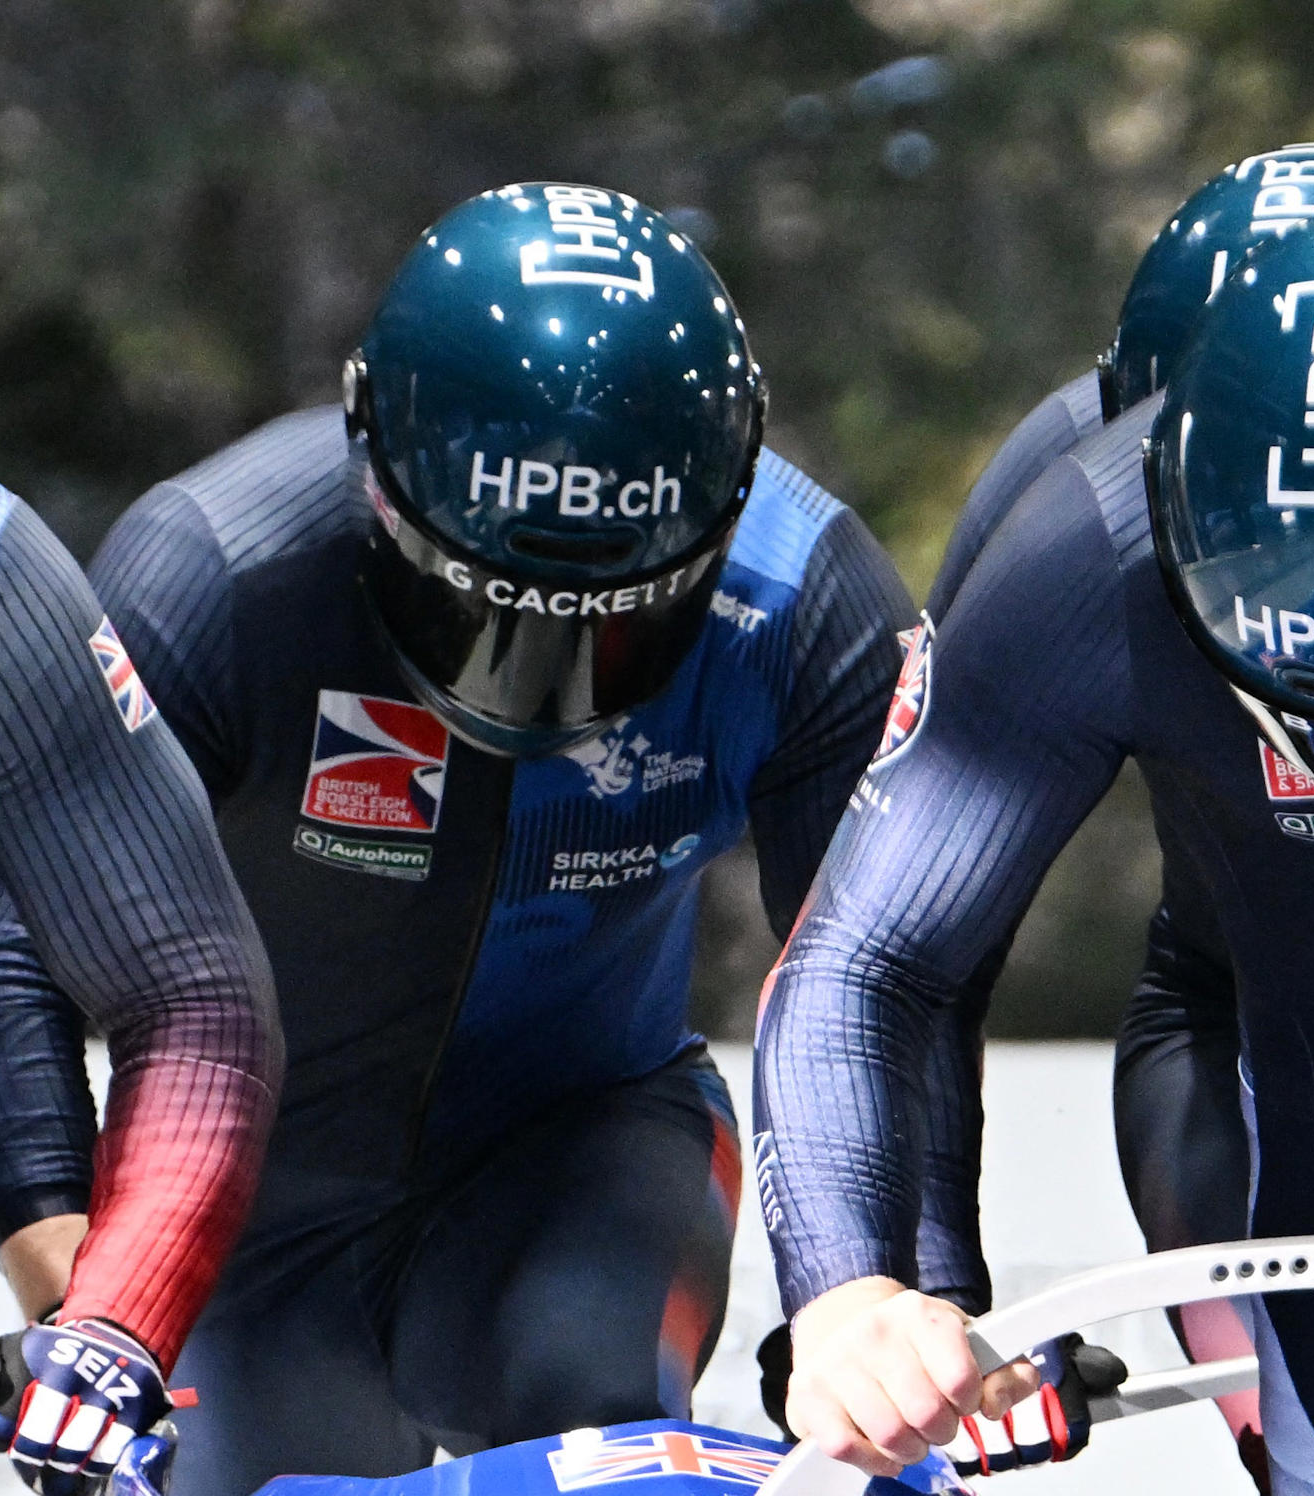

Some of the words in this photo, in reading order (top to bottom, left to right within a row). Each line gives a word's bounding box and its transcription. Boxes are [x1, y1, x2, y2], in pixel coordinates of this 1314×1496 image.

[469, 451, 682, 518] HPB.ch
[445, 561, 473, 592] G
[1280, 710, 1313, 731] B
[319, 776, 382, 795] BRITISH
[316, 789, 407, 809] BOBSLEIGH
[329, 804, 412, 823] SKELETON
[332, 842, 426, 865] Autohorn
[552, 844, 657, 870] SIRKKA
[549, 864, 654, 890] HEALTH
